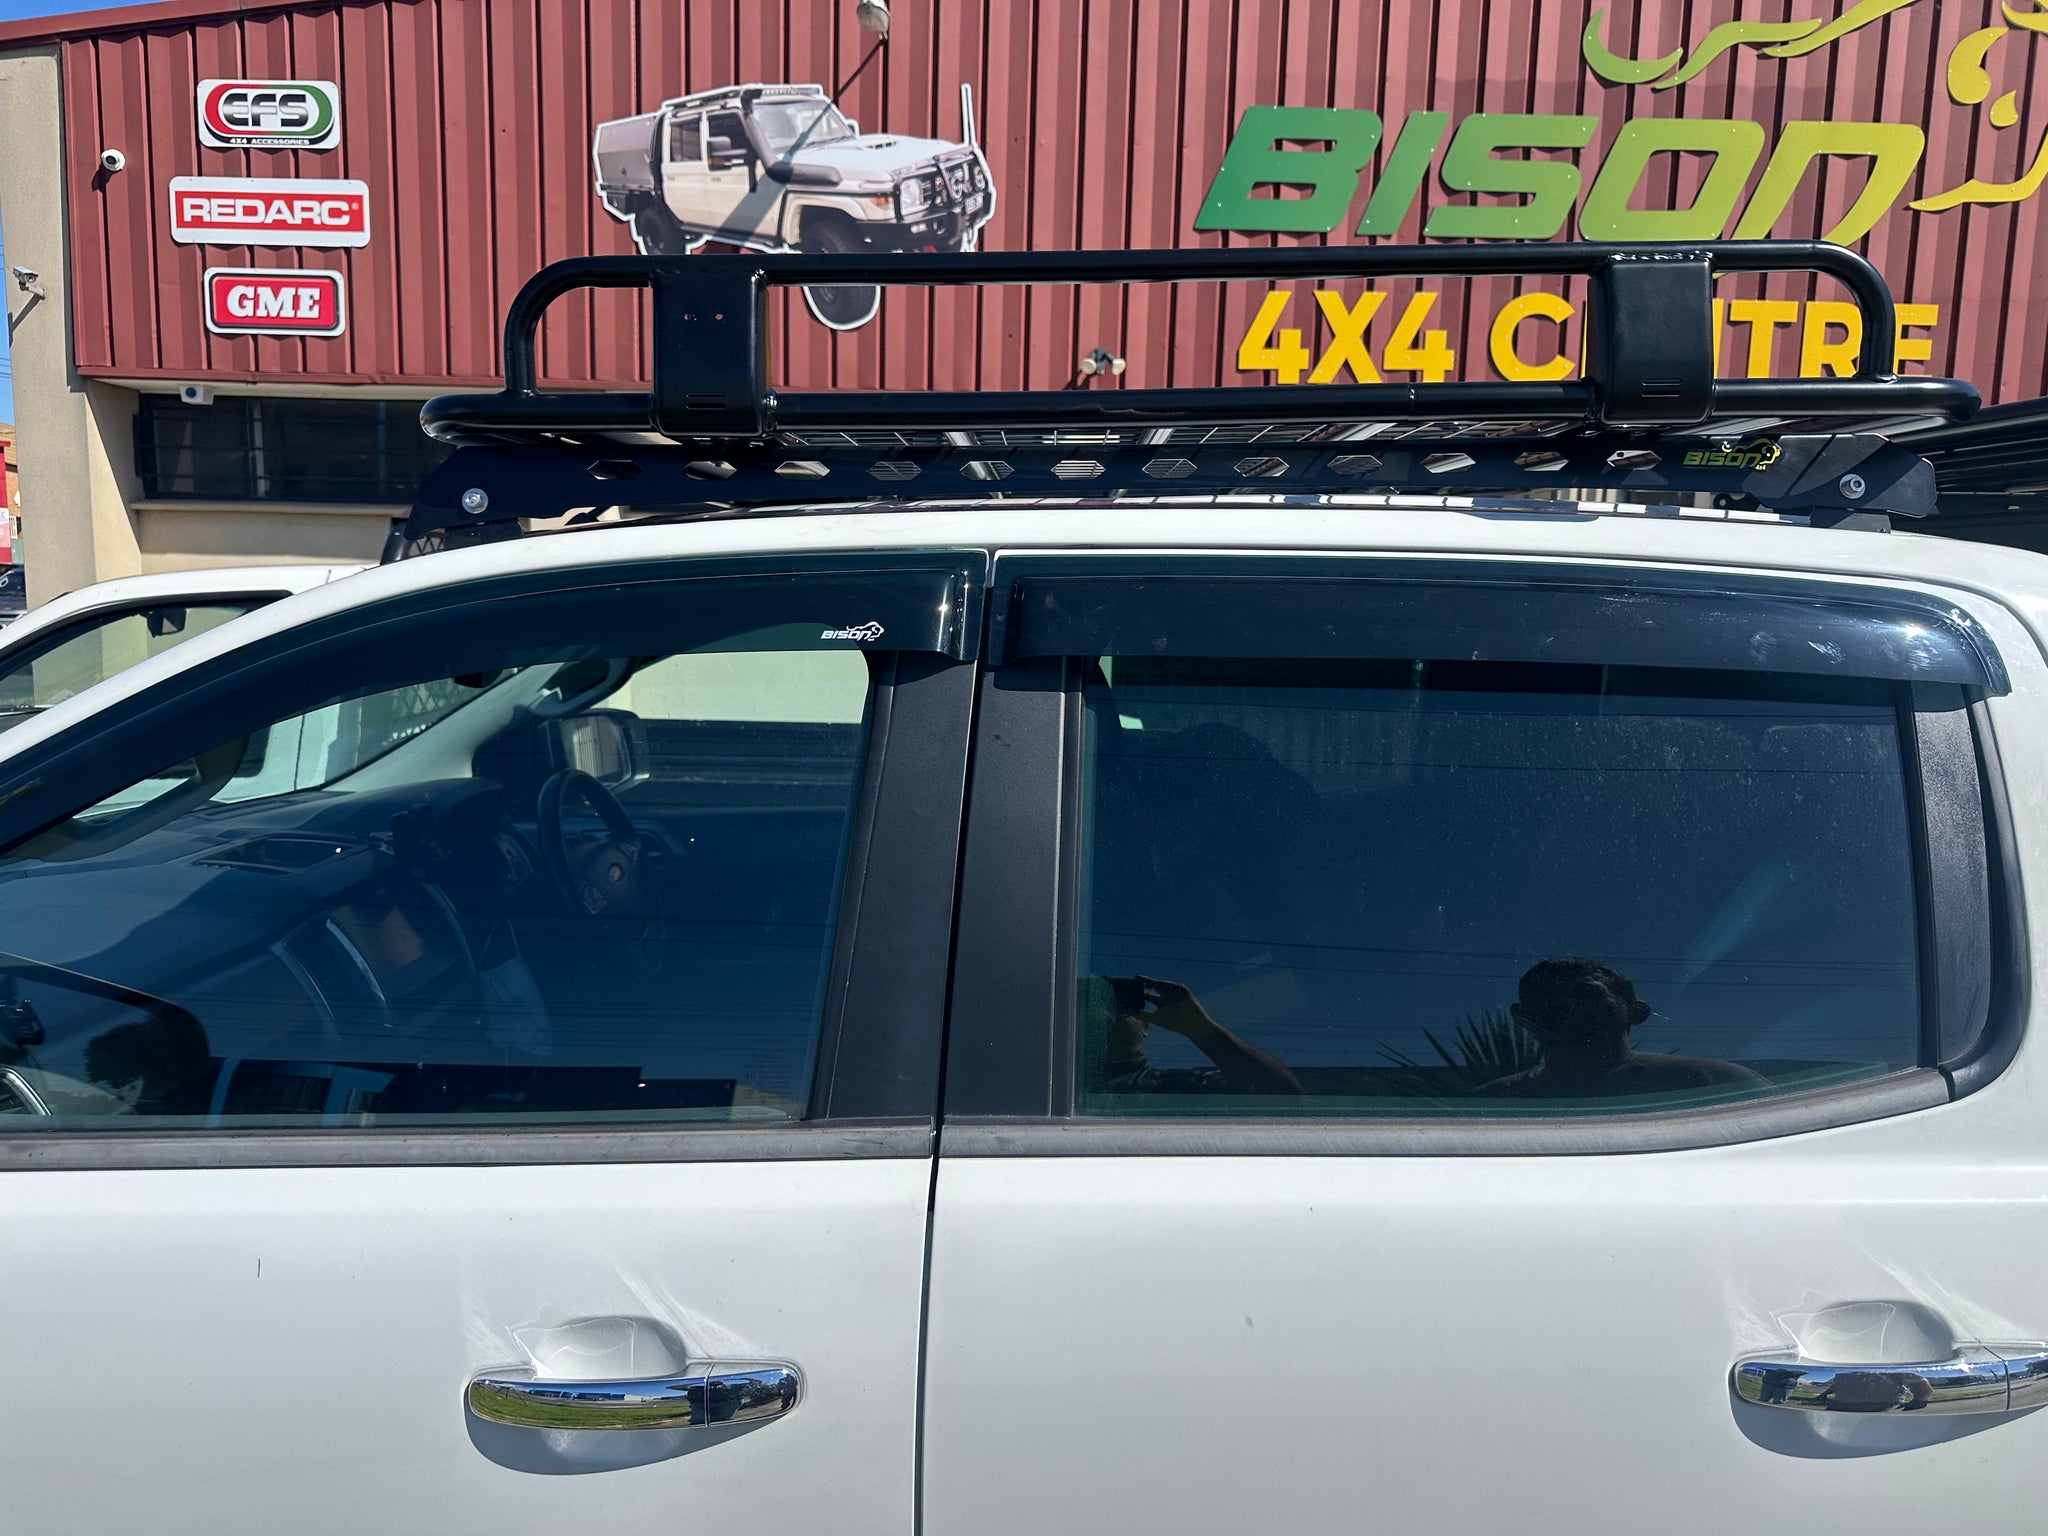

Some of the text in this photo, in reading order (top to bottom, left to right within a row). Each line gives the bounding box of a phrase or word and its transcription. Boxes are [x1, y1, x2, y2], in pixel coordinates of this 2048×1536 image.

[222, 92, 309, 127] EFS
[1194, 105, 1926, 249] BISON
[227, 285, 321, 319] GME
[1237, 290, 1455, 385] 4X4
[1683, 452, 1761, 469] BISON
[821, 631, 872, 641] BISON
